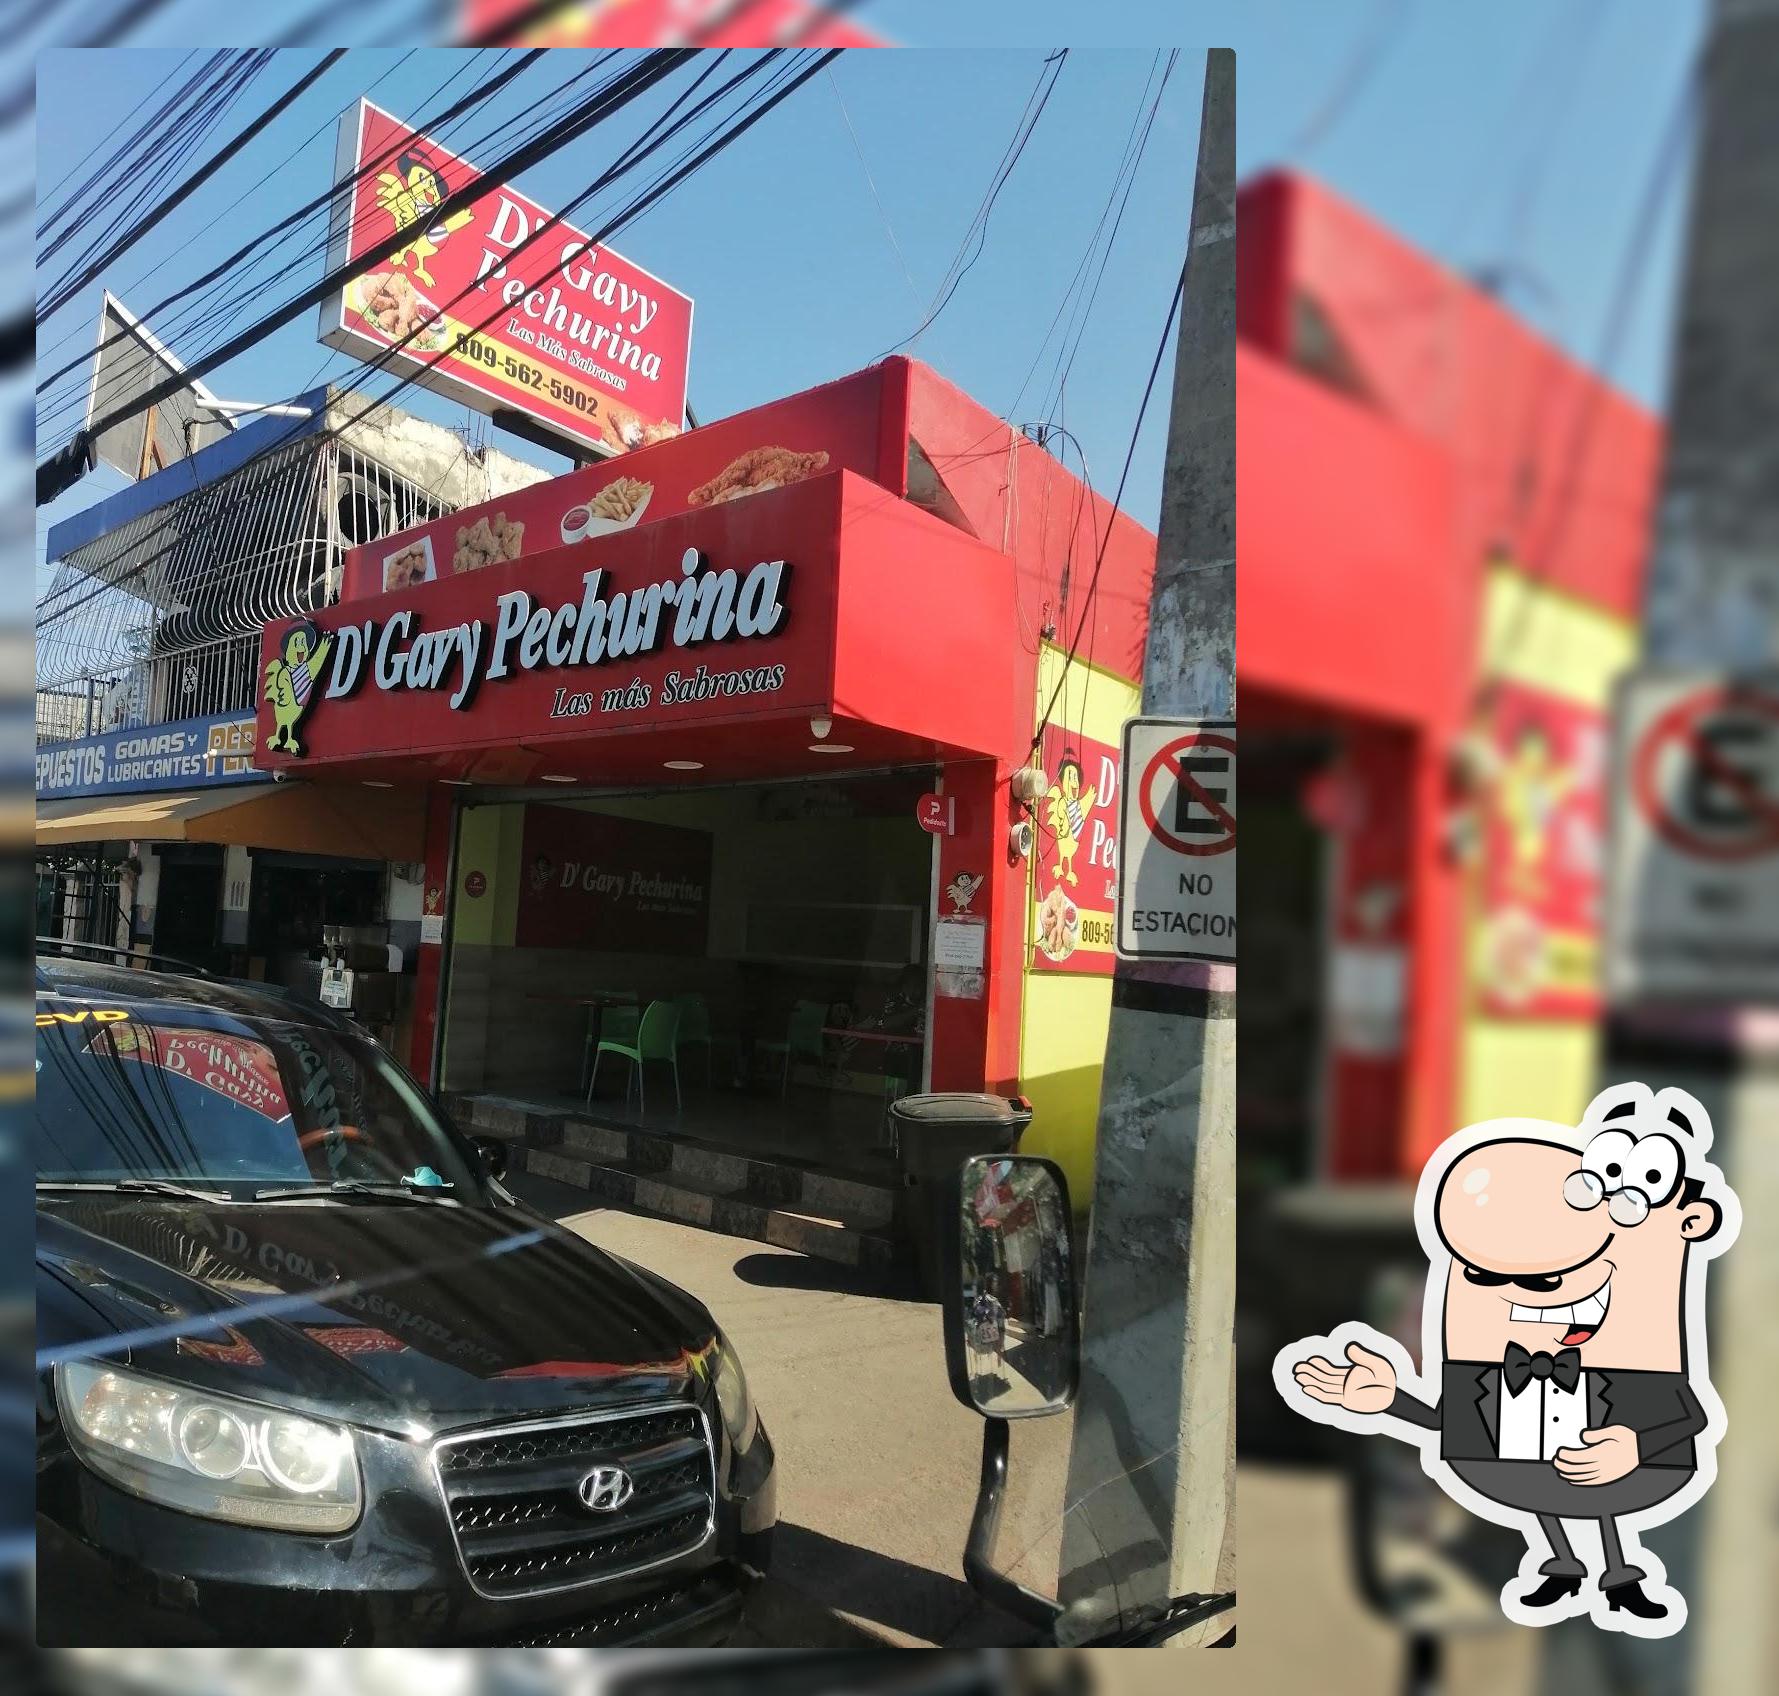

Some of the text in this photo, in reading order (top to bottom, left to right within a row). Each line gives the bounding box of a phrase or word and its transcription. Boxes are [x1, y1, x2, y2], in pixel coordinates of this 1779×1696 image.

[470, 247, 662, 382] Pechurina
[559, 242, 658, 334] Gavy
[455, 331, 599, 418] 809-562-5902
[506, 317, 628, 391] Las Más Sabrosas
[486, 548, 784, 681] Pechurina
[550, 663, 786, 718] Las más Sabrosas
[107, 754, 201, 783] LUBRICANTES
[114, 732, 186, 760] GOMAS
[1088, 818, 1117, 871] Pe
[1178, 872, 1214, 896] NO
[1132, 910, 1236, 938] ESTACION
